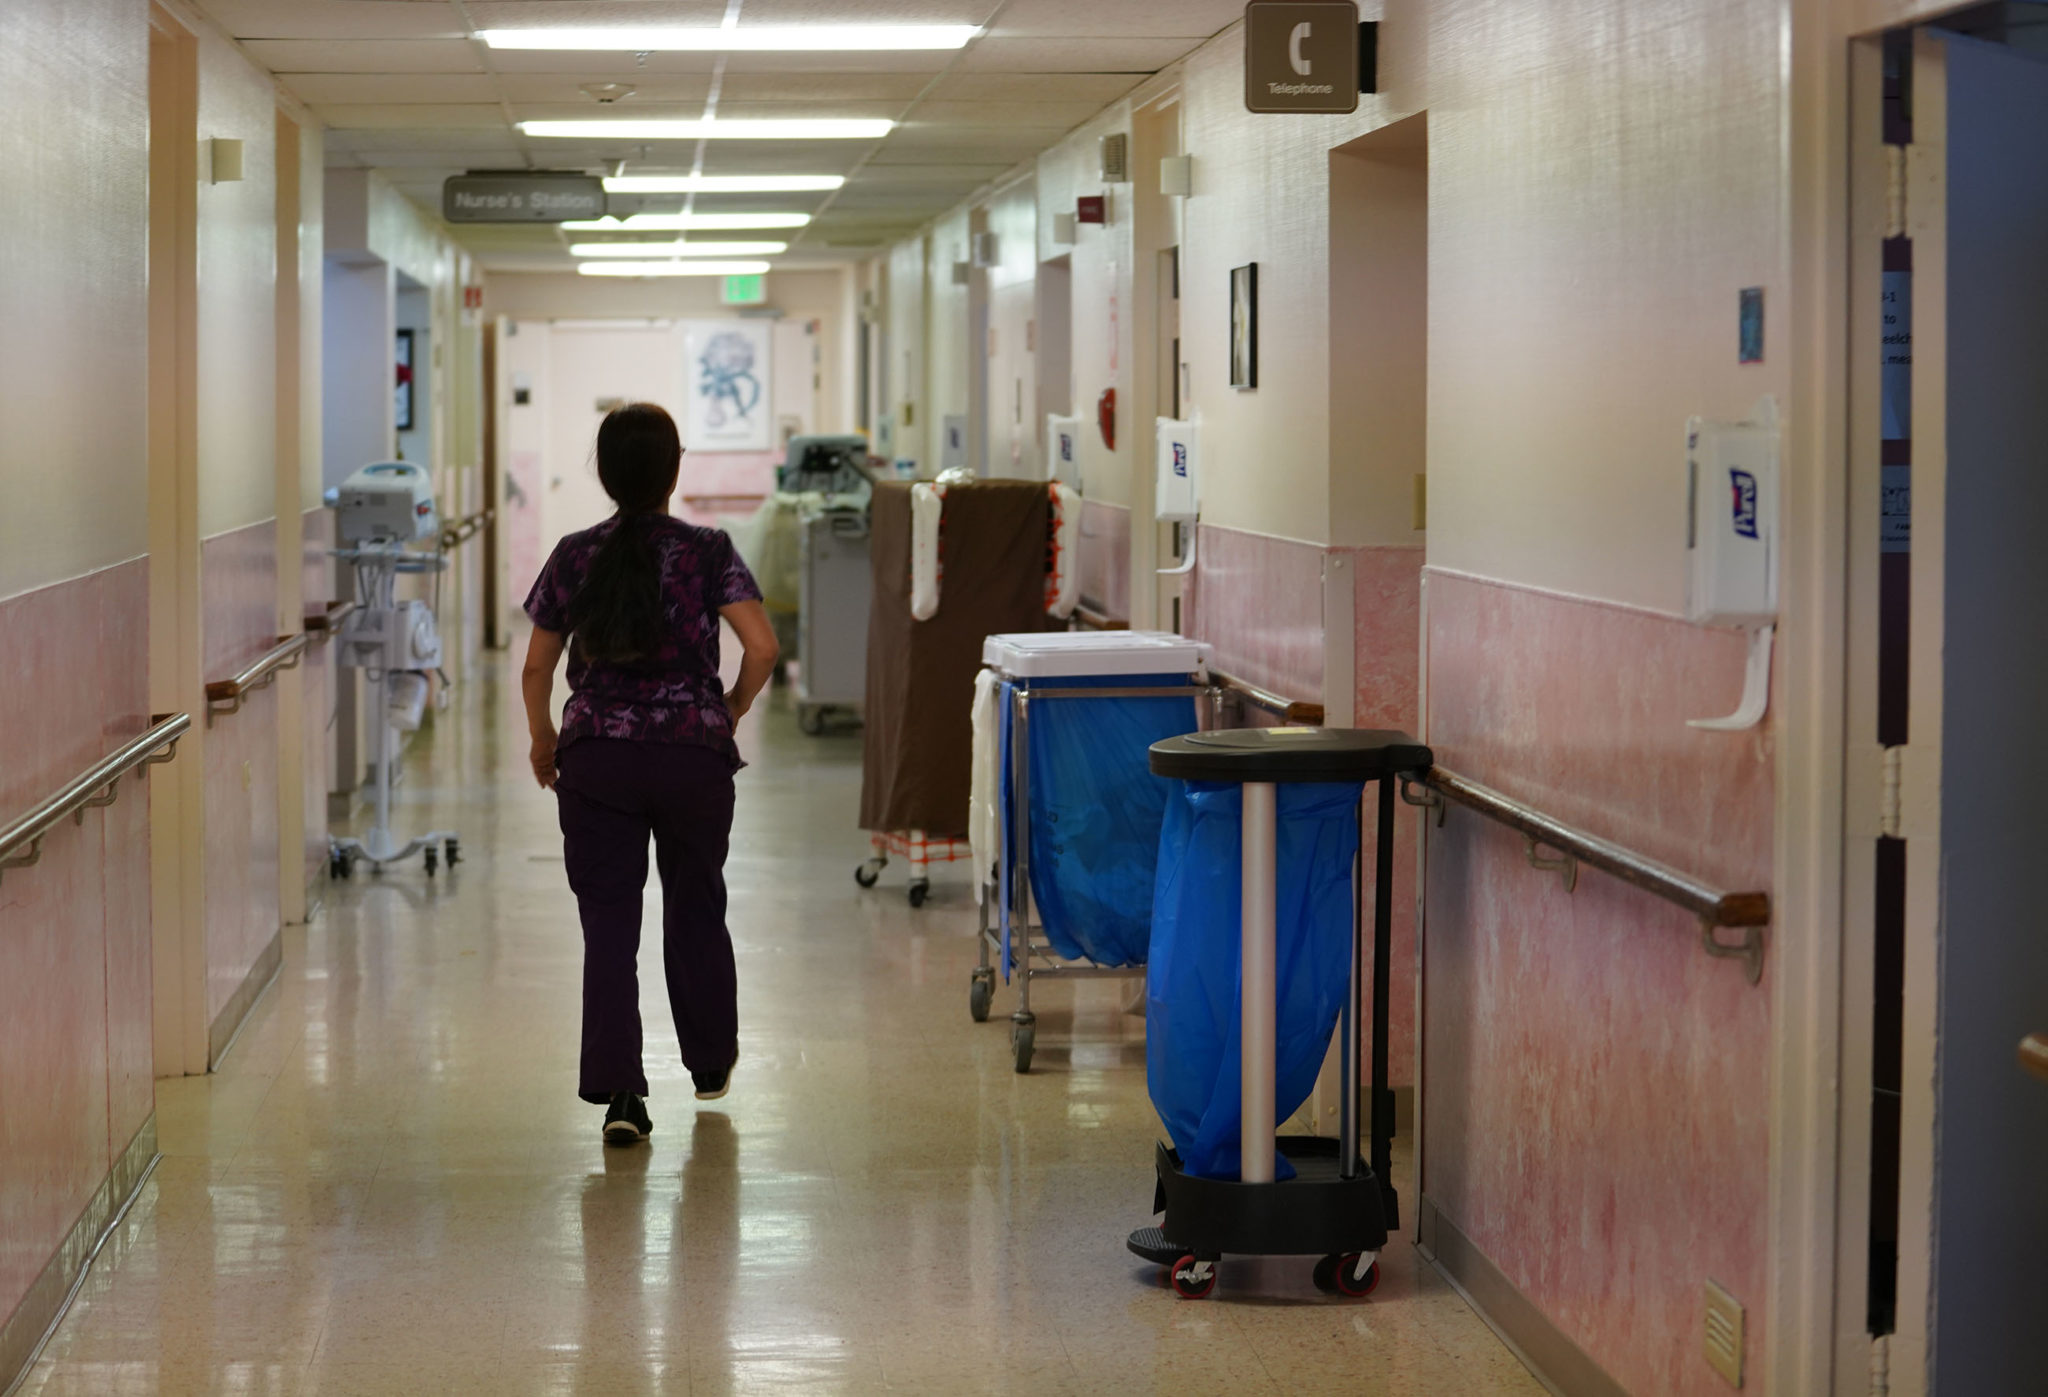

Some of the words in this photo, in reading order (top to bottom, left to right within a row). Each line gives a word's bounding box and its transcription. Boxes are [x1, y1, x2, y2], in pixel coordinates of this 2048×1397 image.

[1268, 82, 1333, 96] Telephone
[455, 192, 522, 208] Nurse's
[530, 191, 594, 208] Station
